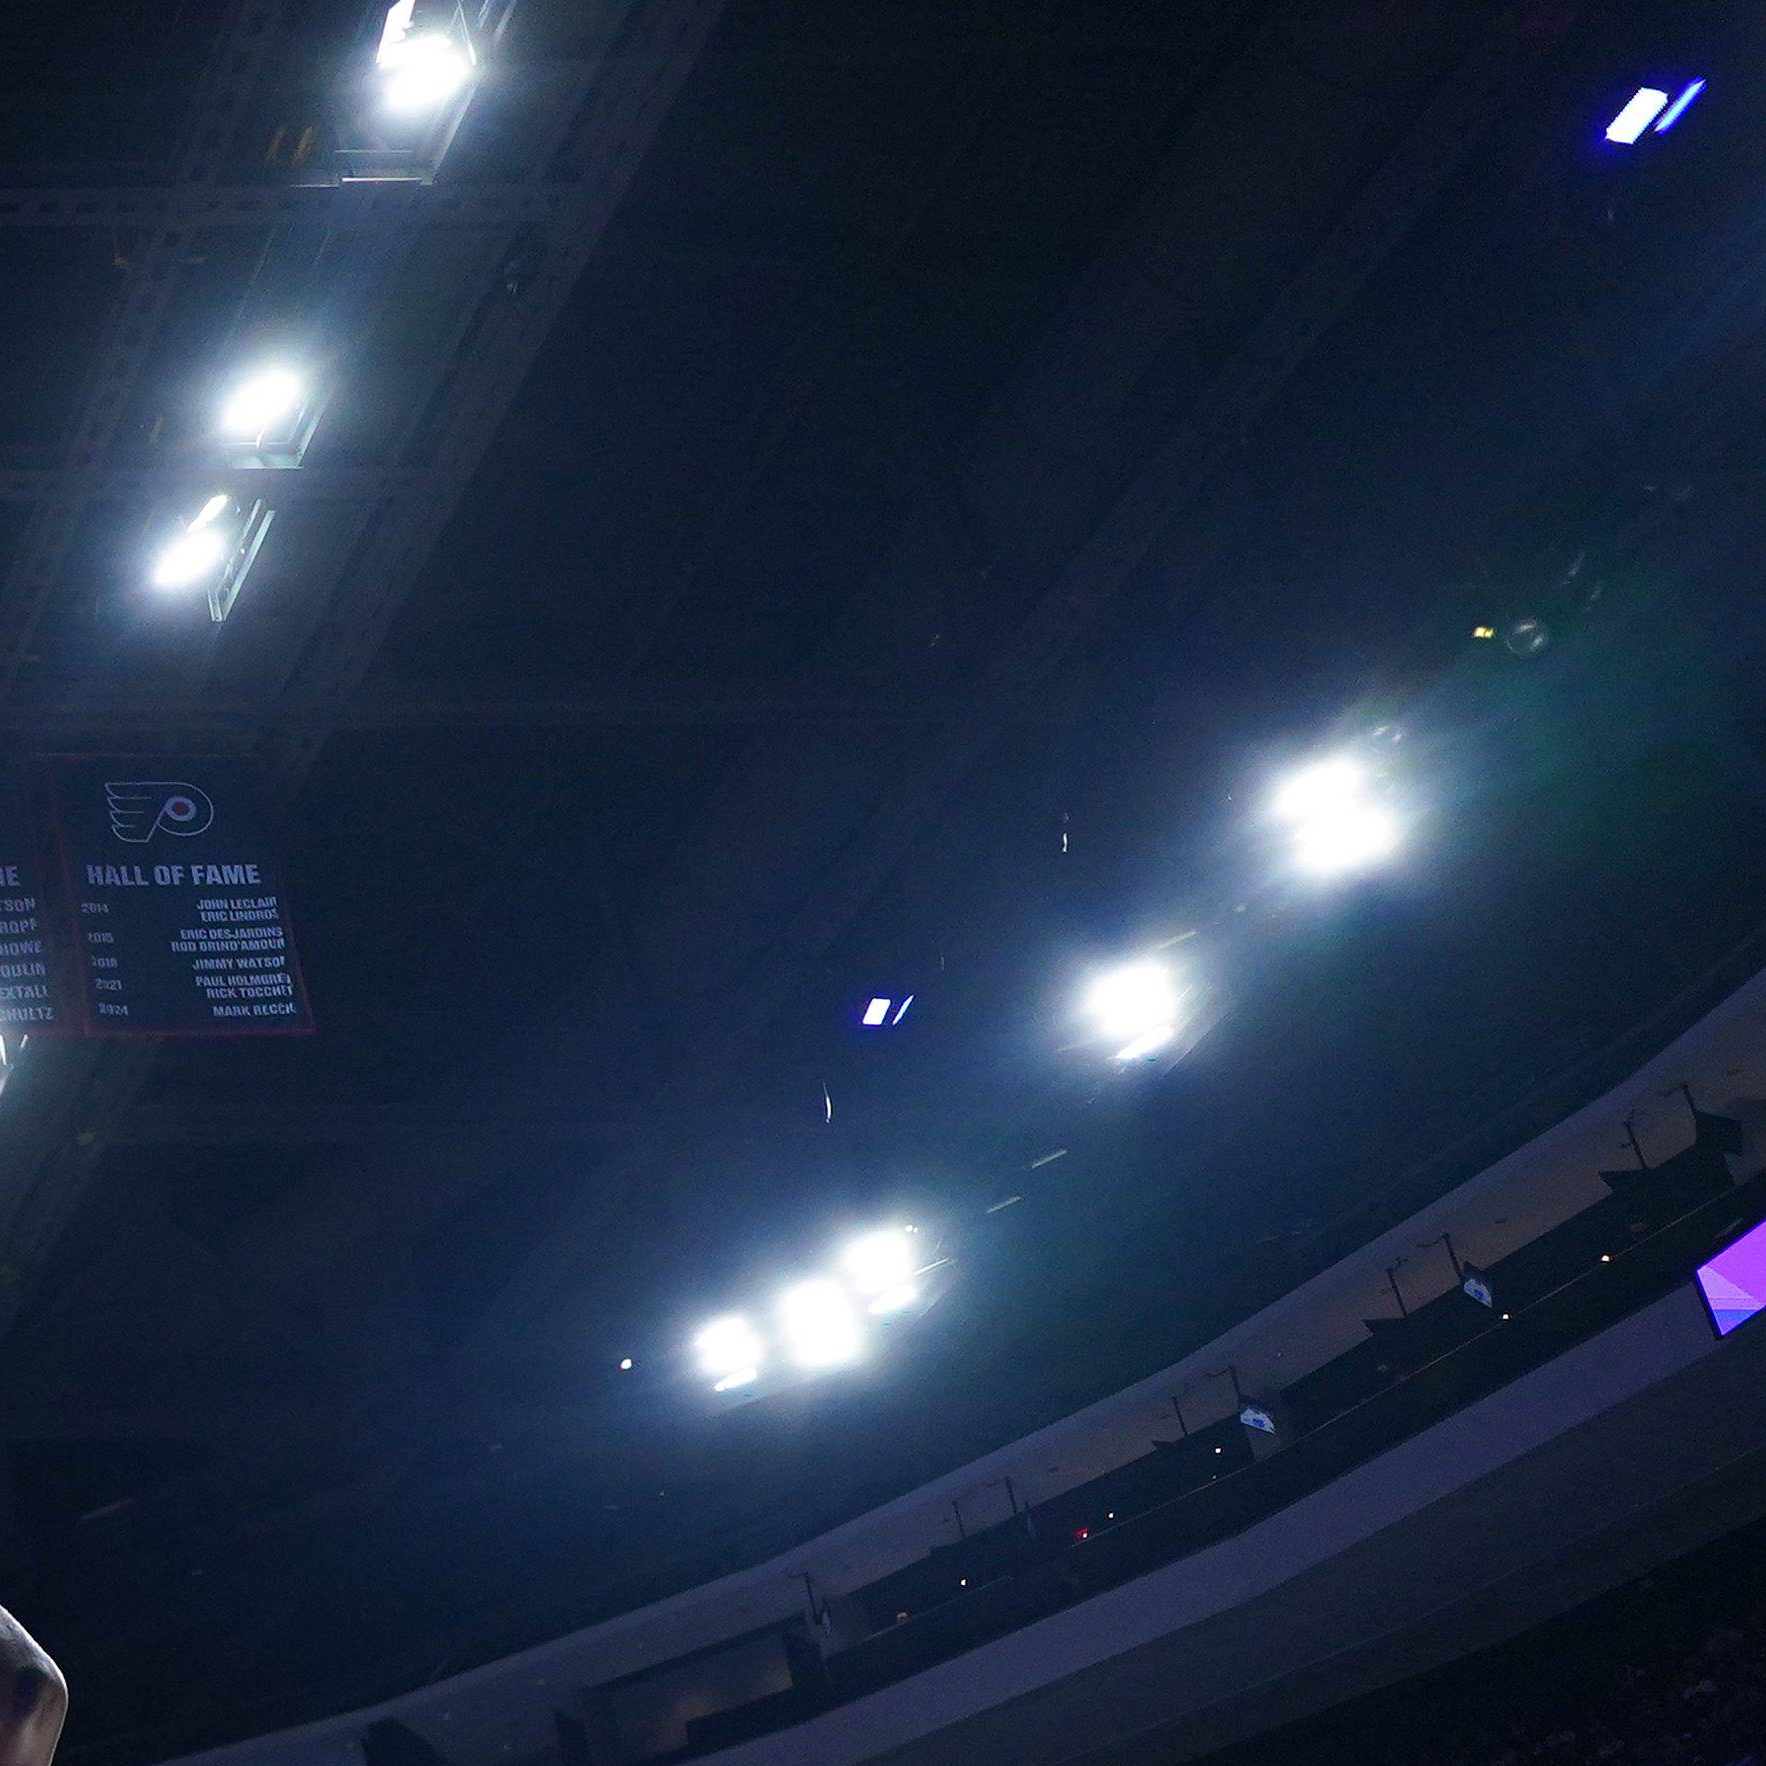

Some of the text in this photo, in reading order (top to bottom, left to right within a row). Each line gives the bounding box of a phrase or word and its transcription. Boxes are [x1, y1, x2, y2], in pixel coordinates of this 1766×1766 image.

[86, 863, 262, 886] HALL OF FAME
[196, 898, 229, 910] JOHN
[200, 908, 279, 922] ERIC LINDROS
[180, 928, 208, 941] ERIC
[209, 926, 284, 941] DESJARDINS
[171, 940, 197, 953] ROD
[192, 958, 233, 971] JIMMY
[195, 975, 228, 988] PAUL
[205, 987, 238, 1000] RICK
[213, 1004, 251, 1017] MARK
